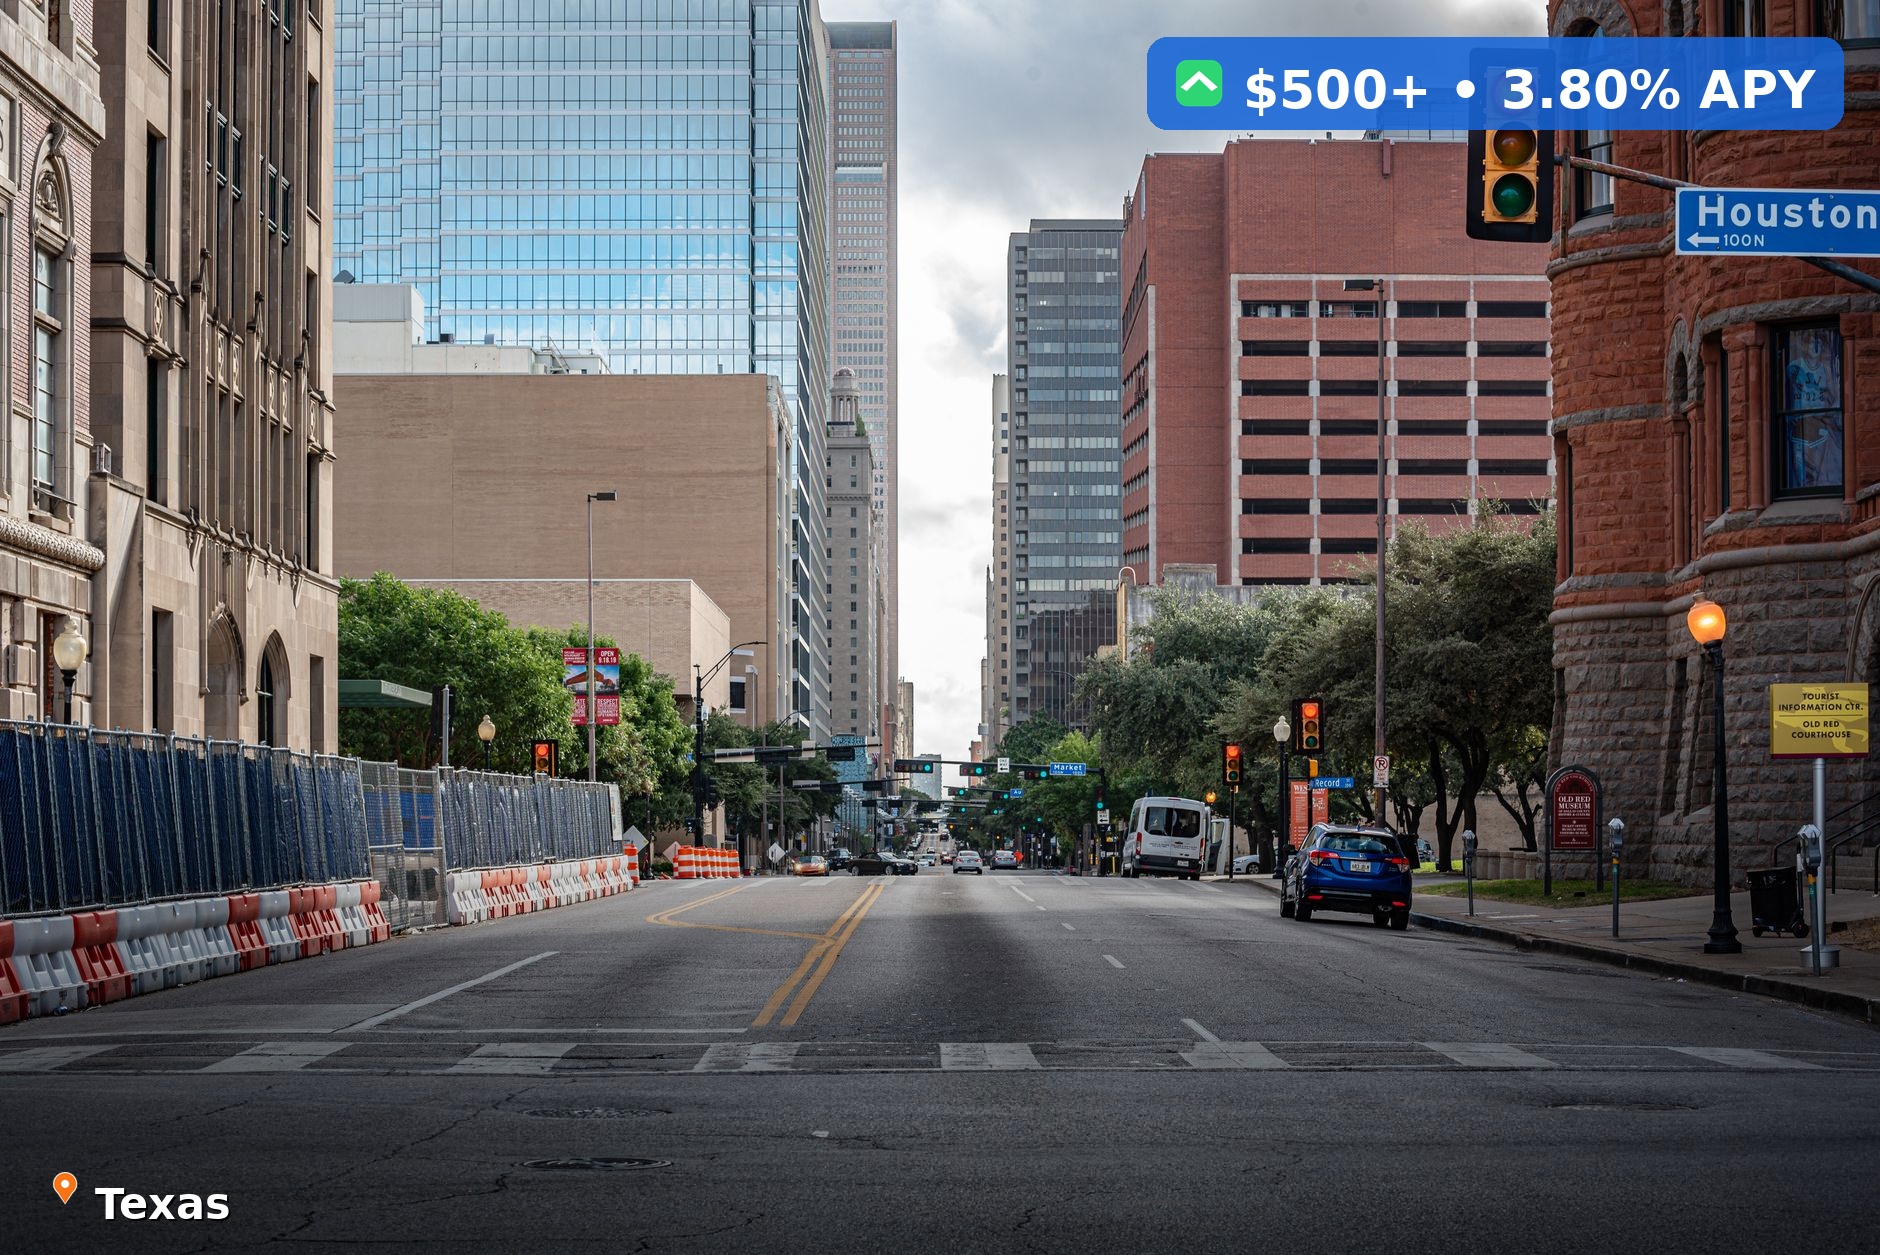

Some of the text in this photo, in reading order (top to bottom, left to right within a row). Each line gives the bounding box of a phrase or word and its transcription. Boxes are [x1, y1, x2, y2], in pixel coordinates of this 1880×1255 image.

[1698, 195, 1877, 230] Houston
[1723, 234, 1765, 247] 100N
[1315, 778, 1340, 788] Record
